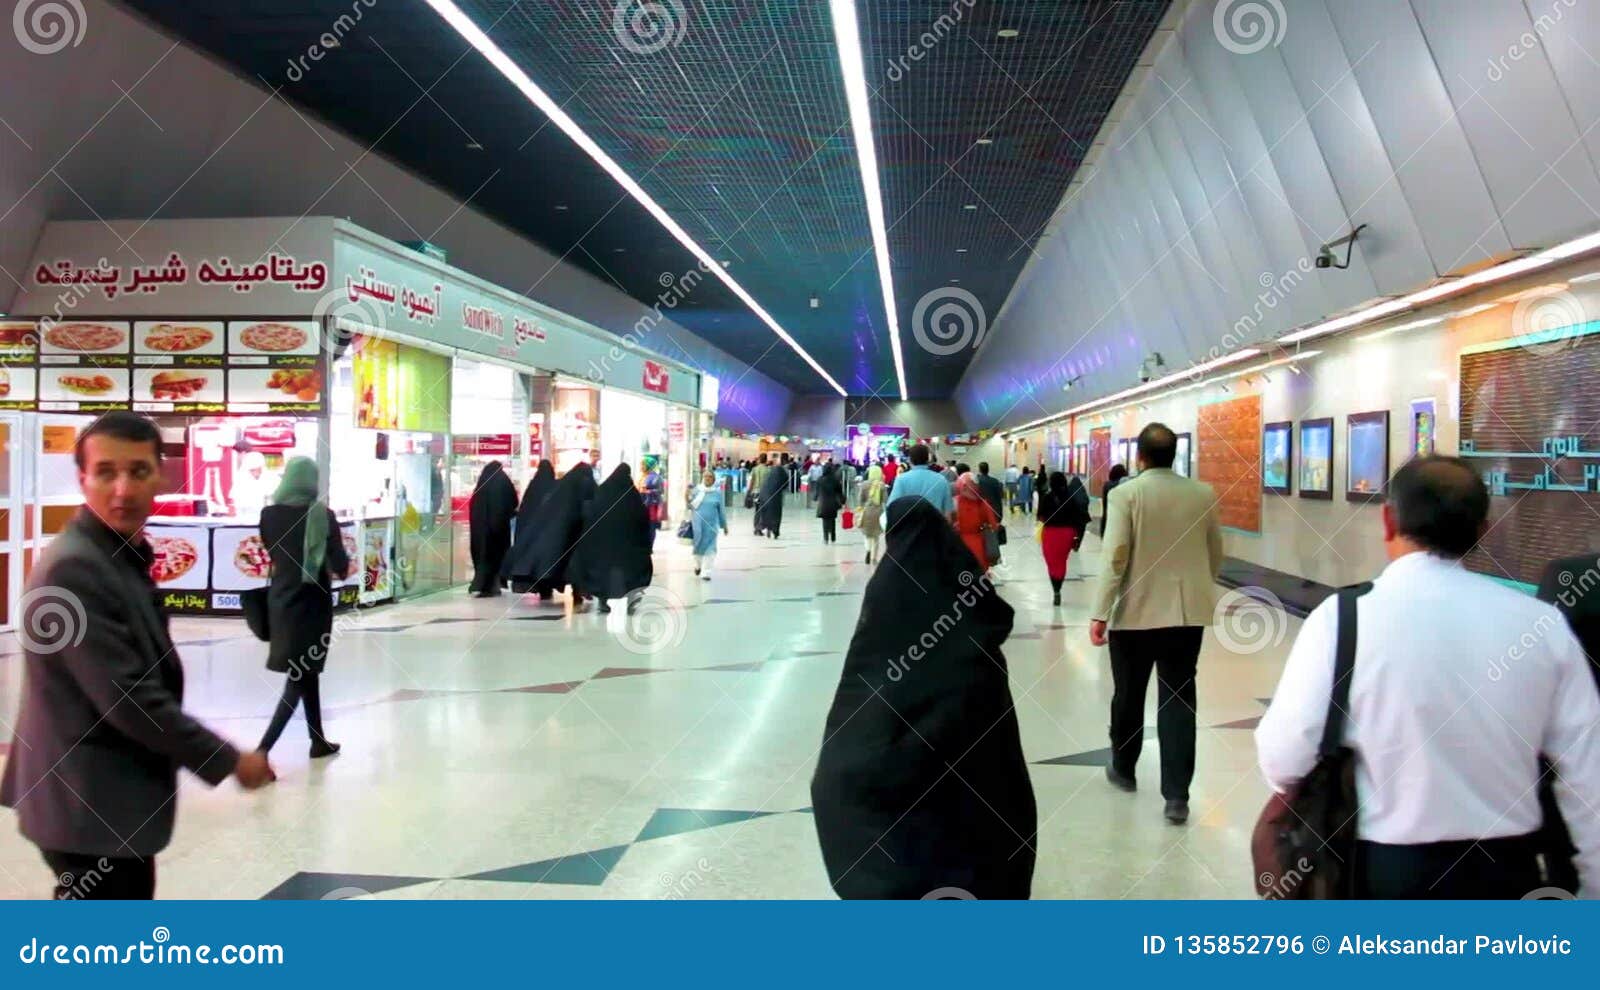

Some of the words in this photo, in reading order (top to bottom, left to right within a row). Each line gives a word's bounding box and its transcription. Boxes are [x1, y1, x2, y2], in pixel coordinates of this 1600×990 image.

[123, 252, 187, 294] شیر
[198, 254, 328, 292] ویتامینه
[346, 265, 396, 316] بستنی
[401, 284, 441, 327] آبمیوه
[217, 595, 242, 607] 500
